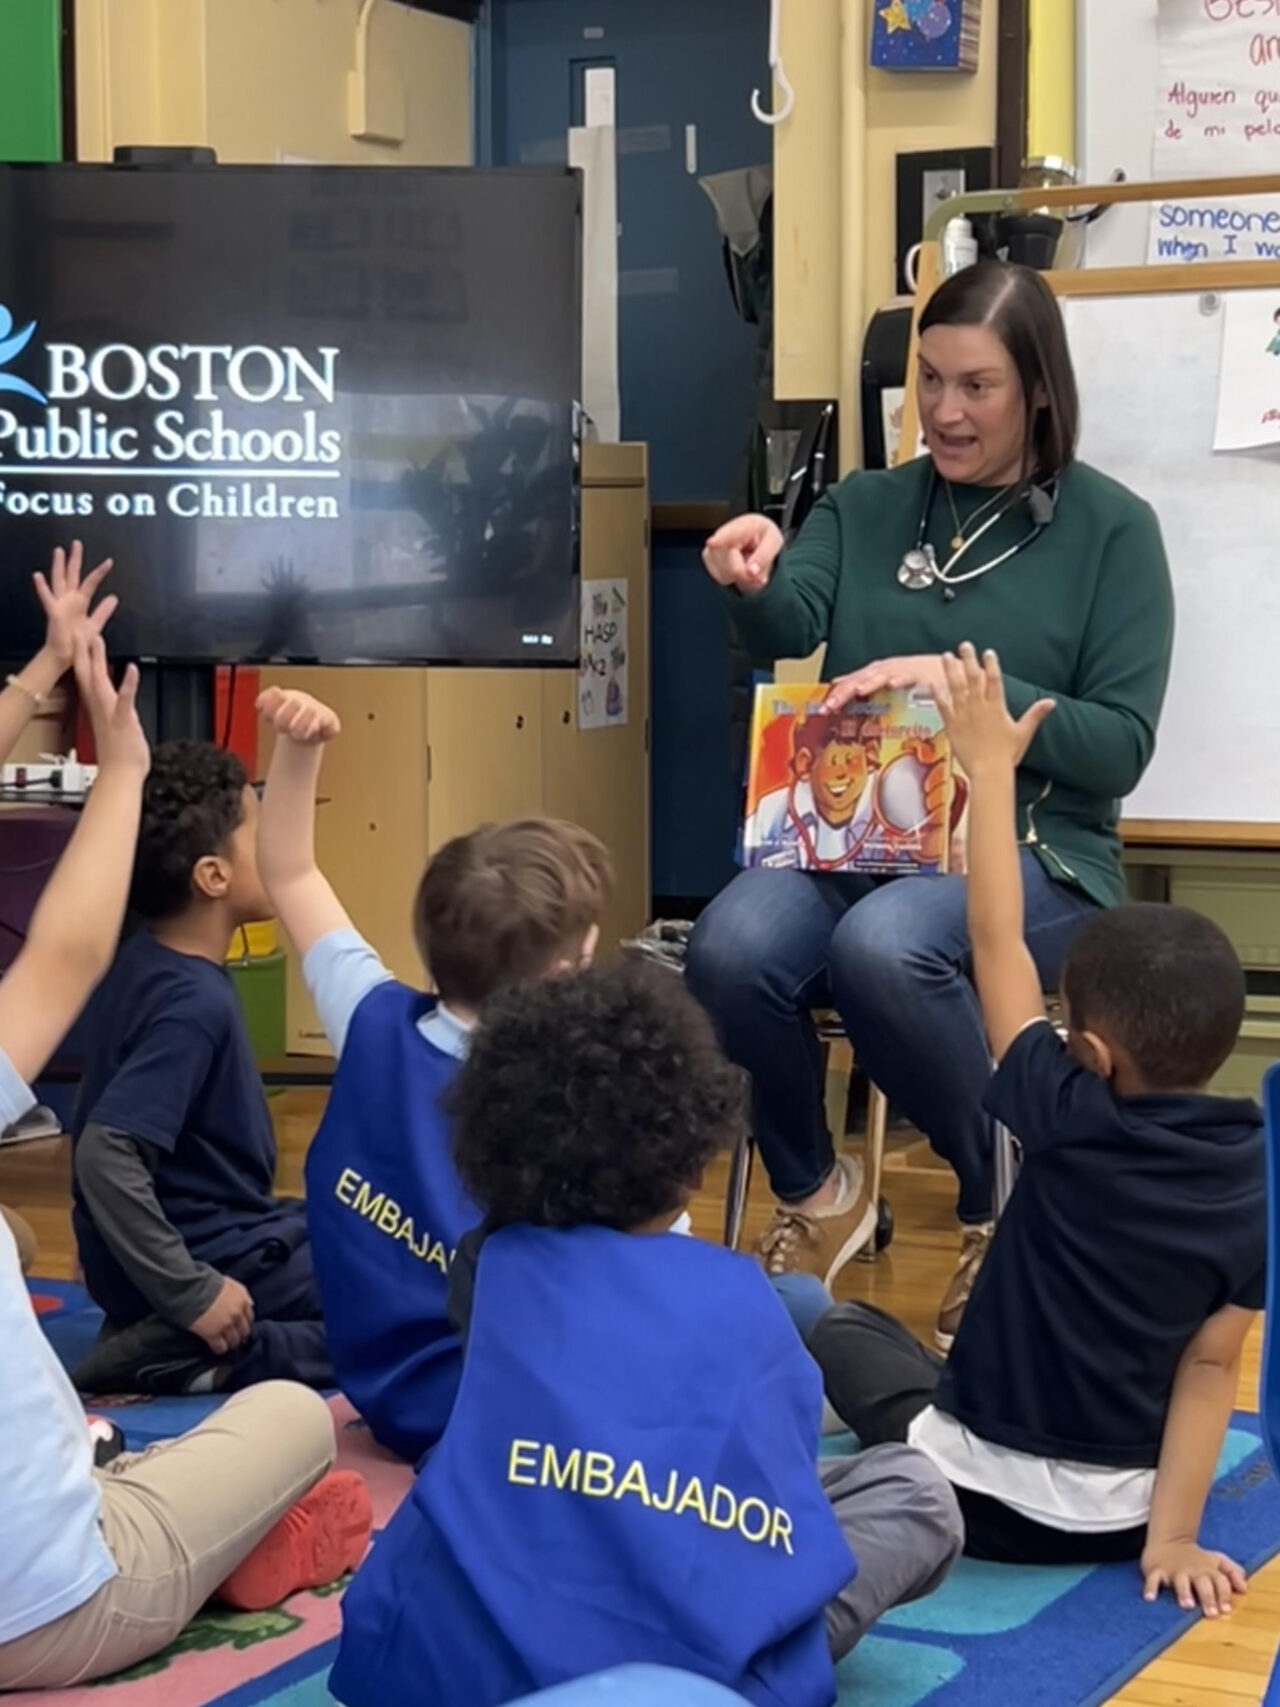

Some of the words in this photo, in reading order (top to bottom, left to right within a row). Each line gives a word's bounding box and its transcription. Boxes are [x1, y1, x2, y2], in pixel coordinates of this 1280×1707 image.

[1168, 82, 1236, 118] Alguien
[1165, 120, 1182, 139] de
[1204, 125, 1225, 137] mi
[1222, 234, 1238, 254] I
[46, 344, 340, 402] BOSTON
[153, 410, 341, 463] Schools
[106, 495, 156, 517] on
[167, 482, 340, 518] Children
[507, 1438, 795, 1556] EMBAJADOR
